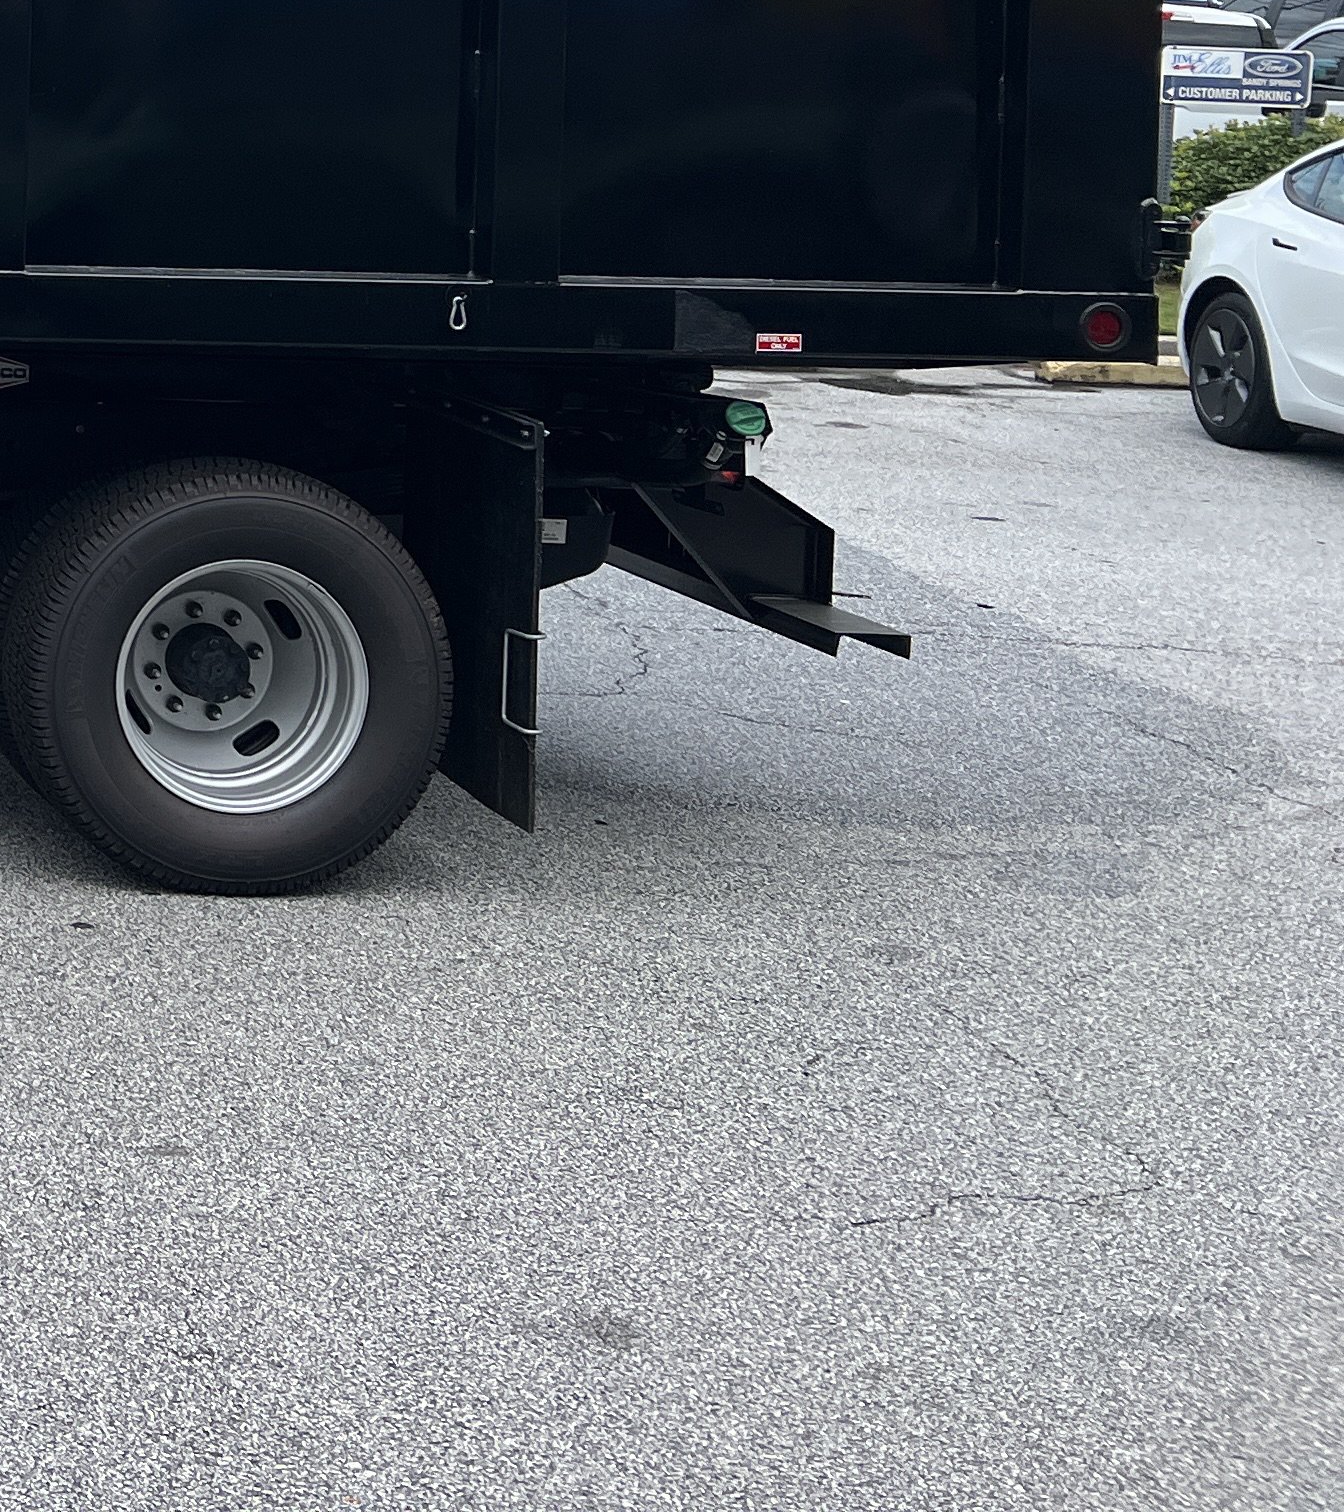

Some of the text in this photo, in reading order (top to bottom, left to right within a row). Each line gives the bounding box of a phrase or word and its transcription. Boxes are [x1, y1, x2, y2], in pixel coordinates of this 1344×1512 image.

[1171, 51, 1233, 75] JIM Ellis
[1257, 60, 1289, 73] Ford
[1178, 87, 1292, 102] CUSTOMER PARKING
